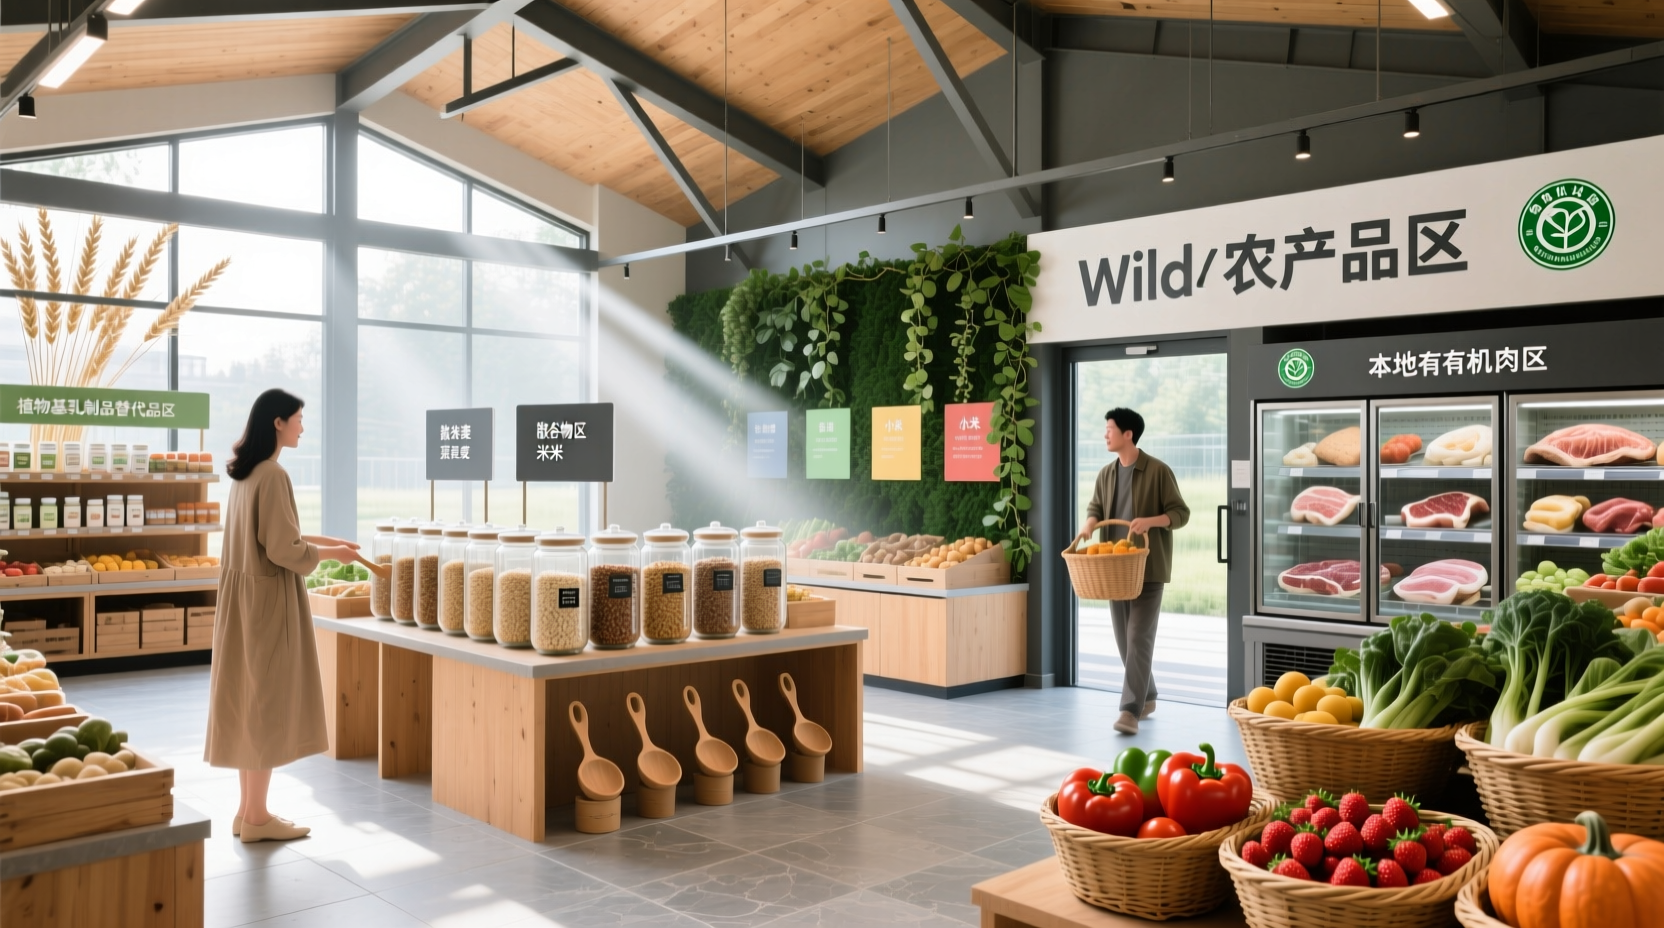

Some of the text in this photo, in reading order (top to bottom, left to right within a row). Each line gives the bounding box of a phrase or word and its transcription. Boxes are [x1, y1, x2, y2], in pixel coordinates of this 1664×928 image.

[1369, 345, 1548, 377] 本地有有机肉区
